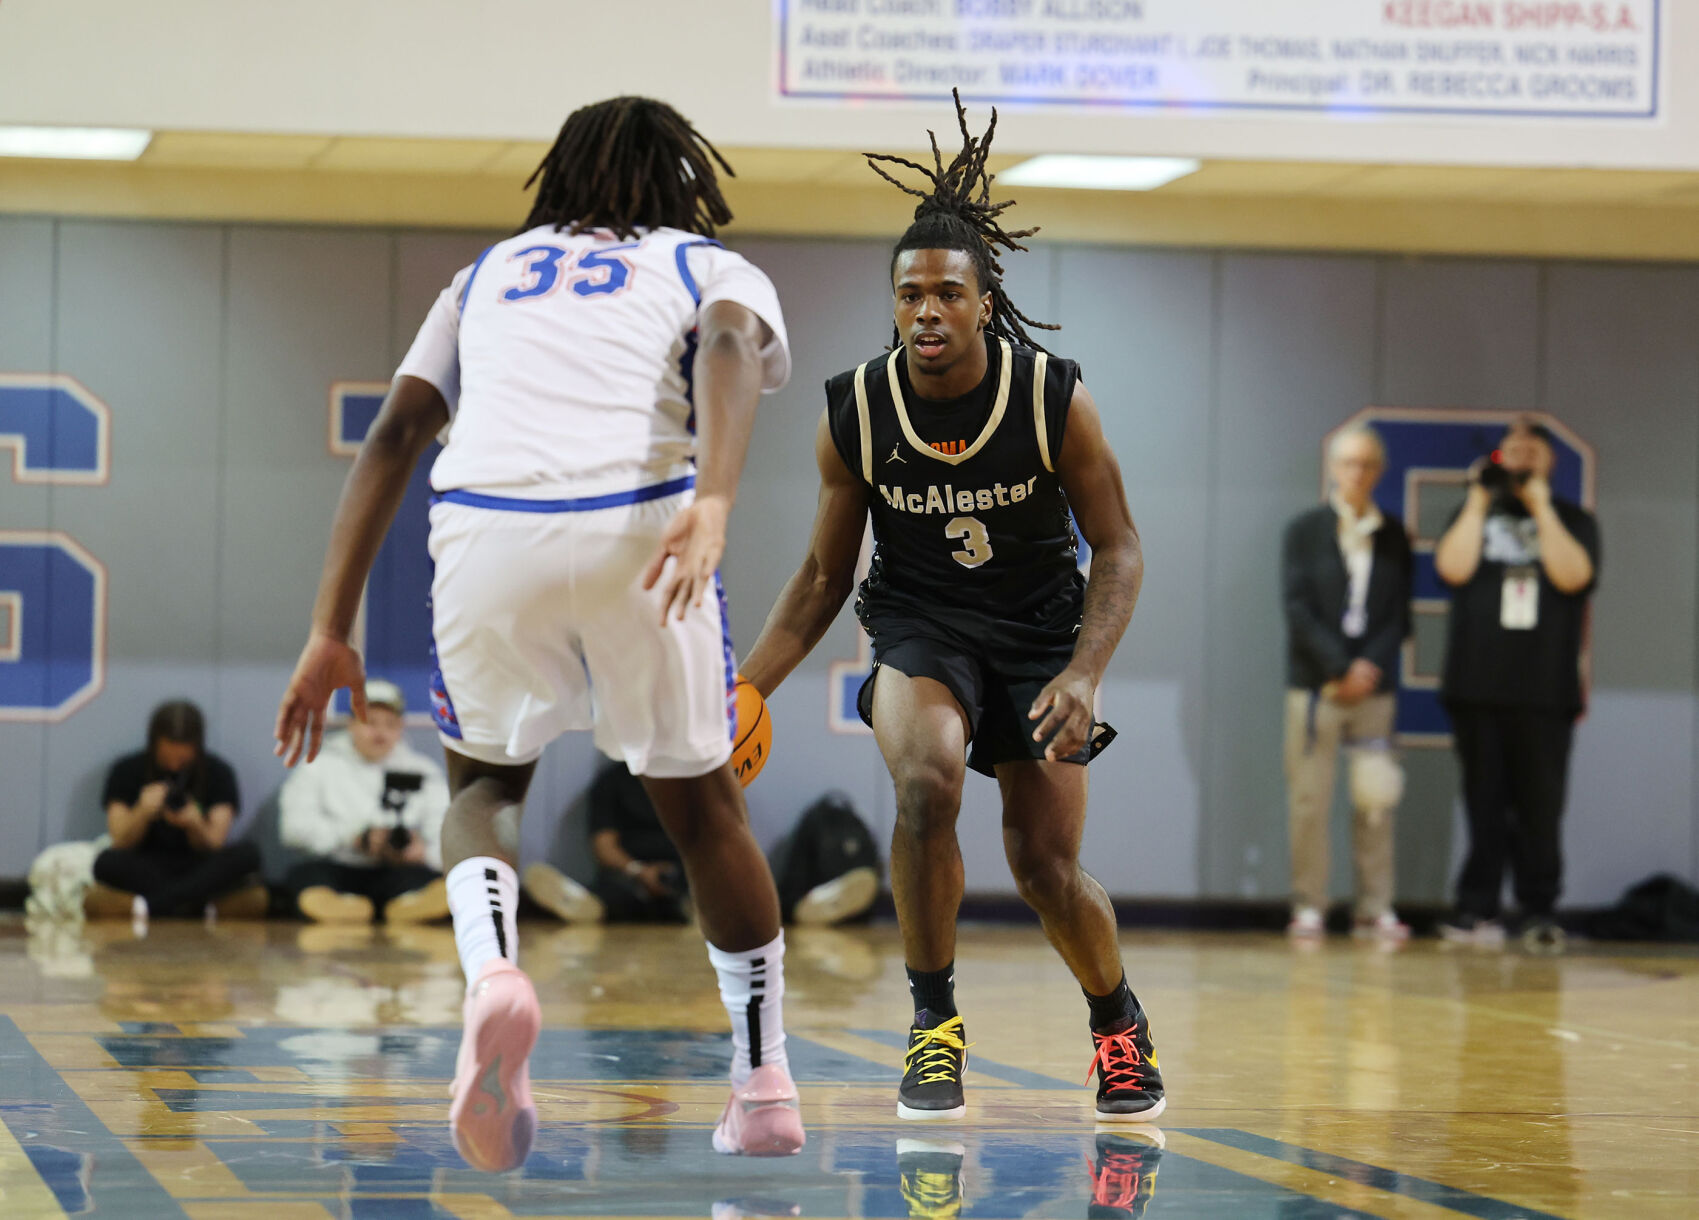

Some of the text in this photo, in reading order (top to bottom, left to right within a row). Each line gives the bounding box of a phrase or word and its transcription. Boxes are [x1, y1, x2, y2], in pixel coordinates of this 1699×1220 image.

[1042, 0, 1144, 20] ALLISON
[1383, 1, 1494, 28] KEEGAN
[802, 59, 885, 82] Athletic
[1000, 62, 1064, 85] MARK
[1075, 63, 1159, 88] DOVER
[1408, 71, 1521, 98] REBECCA
[1529, 74, 1638, 100] GROOMS
[499, 240, 648, 304] 35
[879, 475, 1038, 514] McAlester
[945, 516, 994, 569] 3
